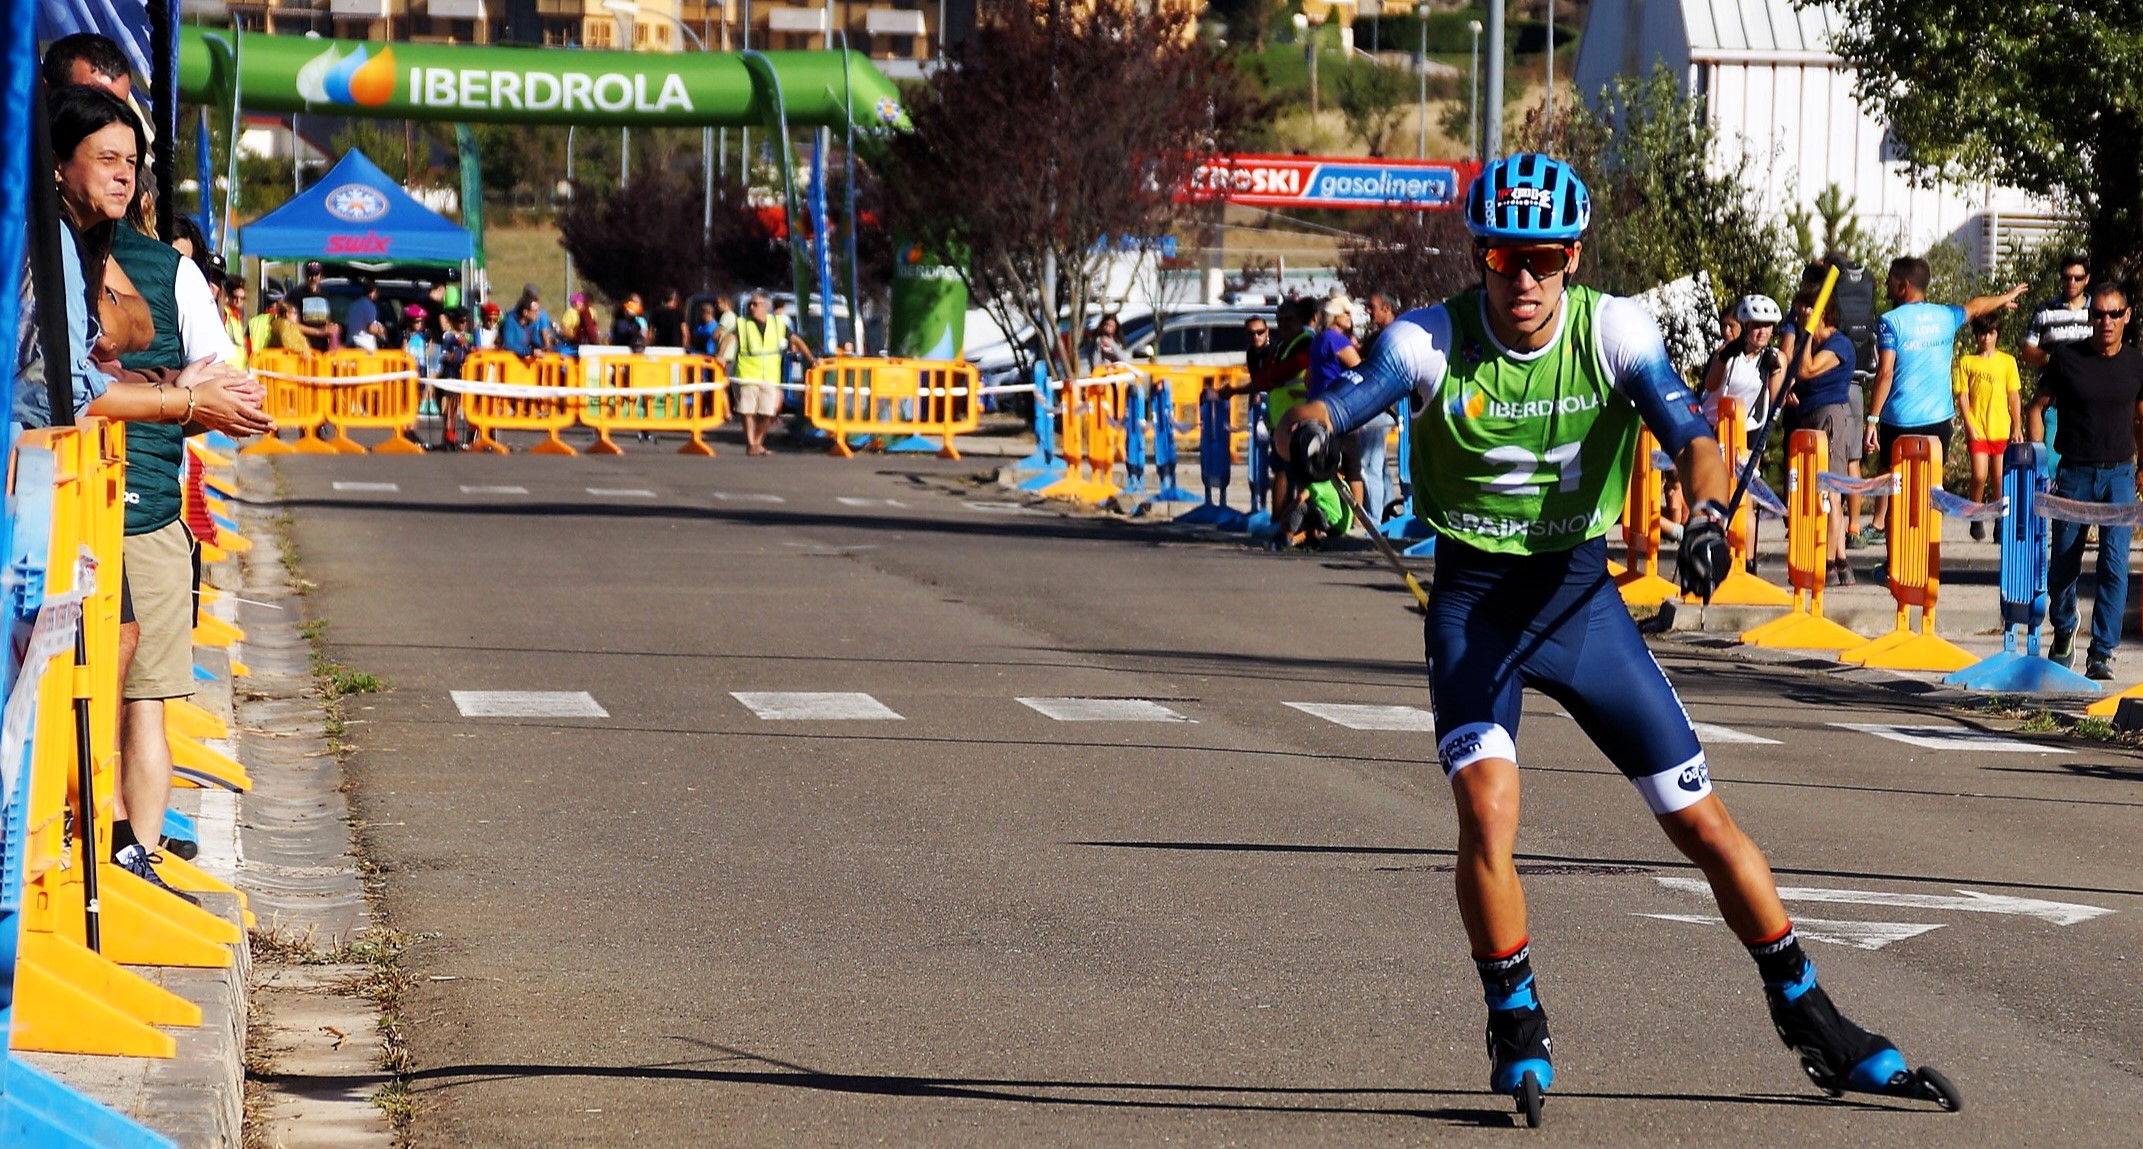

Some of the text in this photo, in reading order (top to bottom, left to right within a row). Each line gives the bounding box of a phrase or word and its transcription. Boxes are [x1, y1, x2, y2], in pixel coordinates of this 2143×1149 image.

[409, 67, 695, 112] IBERDROLA
[1320, 168, 1446, 197] gasolinera
[1480, 441, 1582, 495] 21
